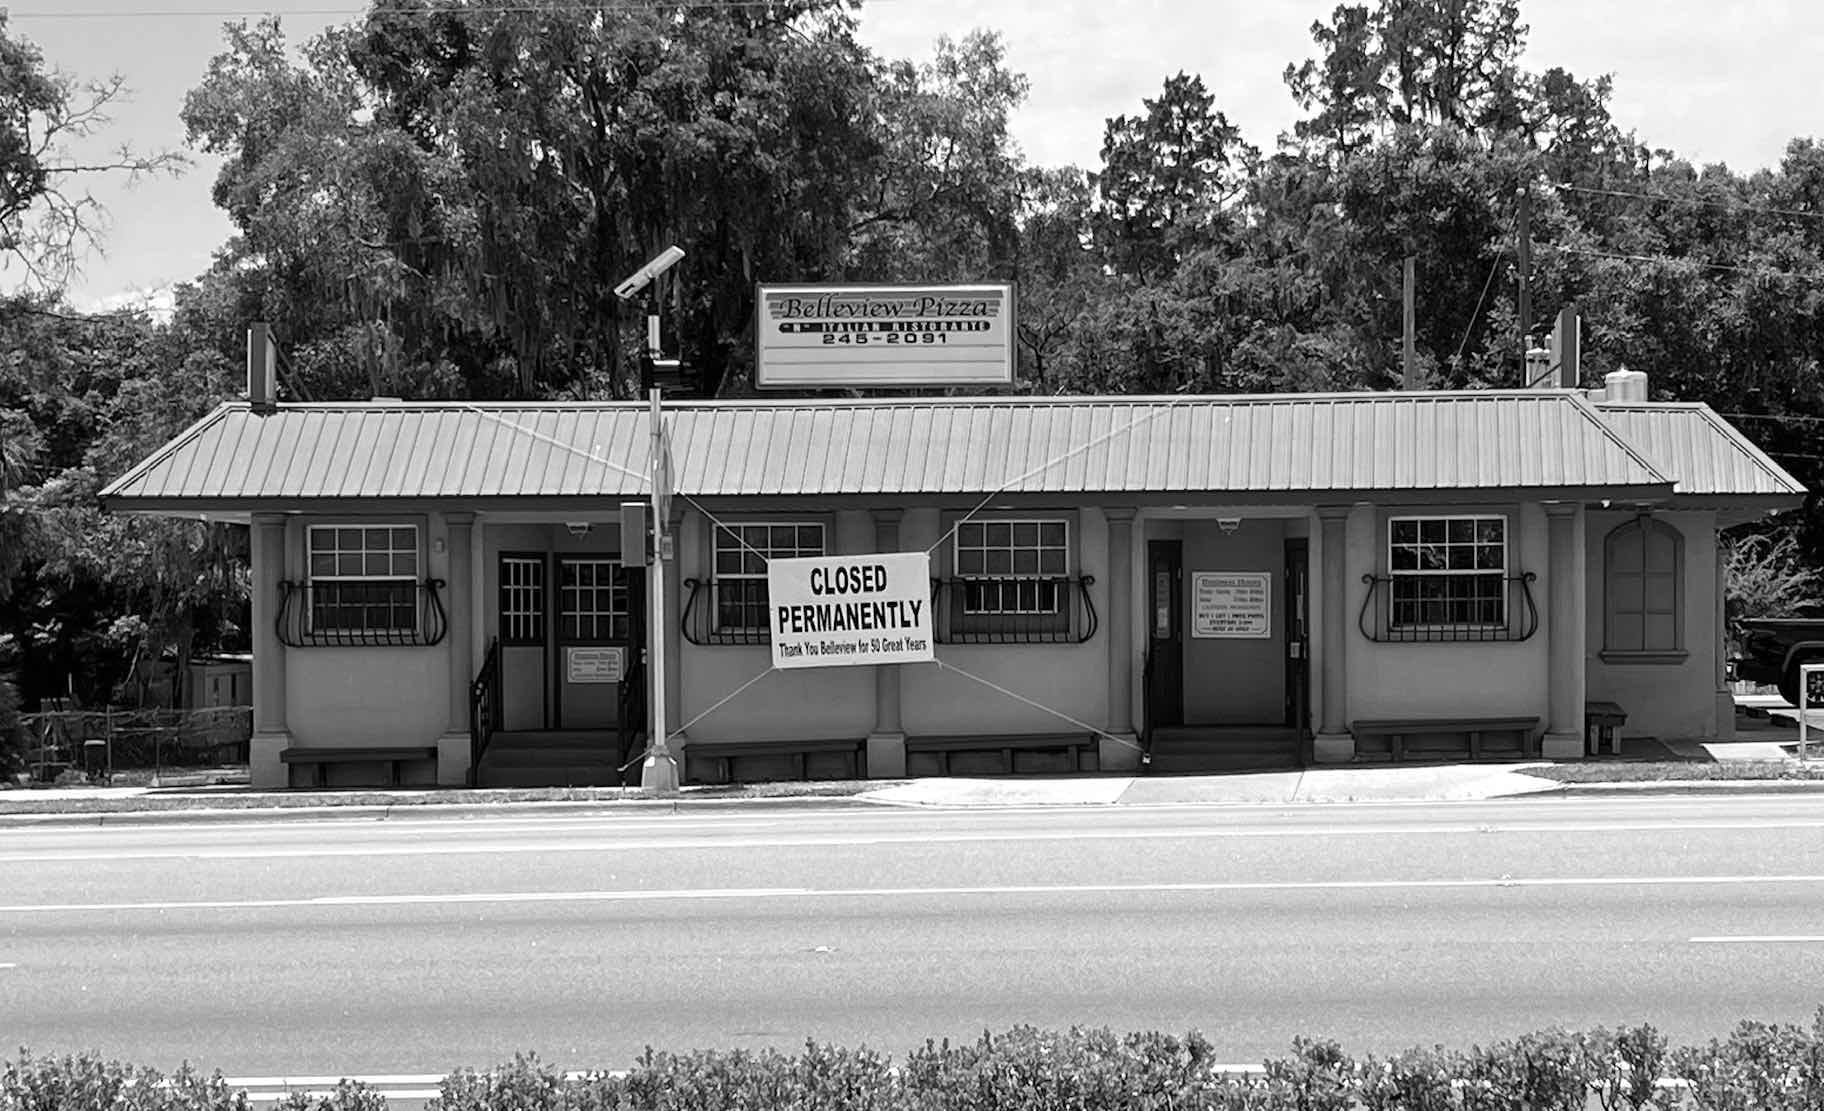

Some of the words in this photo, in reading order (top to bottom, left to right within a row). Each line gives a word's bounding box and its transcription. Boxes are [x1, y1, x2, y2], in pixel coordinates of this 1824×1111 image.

[780, 293, 904, 318] Belleview
[913, 296, 988, 317] Pizza
[822, 322, 880, 333] ITALIAN
[892, 321, 985, 332] RISTORANTE
[822, 333, 946, 344] 245-2091
[810, 564, 887, 596] CLOSED
[778, 600, 922, 634] PERMANENTLY
[779, 642, 803, 658] Thank
[804, 641, 819, 656] You
[820, 640, 858, 656] Belleview
[858, 639, 869, 654] for
[871, 638, 881, 653] 50
[882, 638, 904, 653] Great
[905, 636, 928, 652] Years
